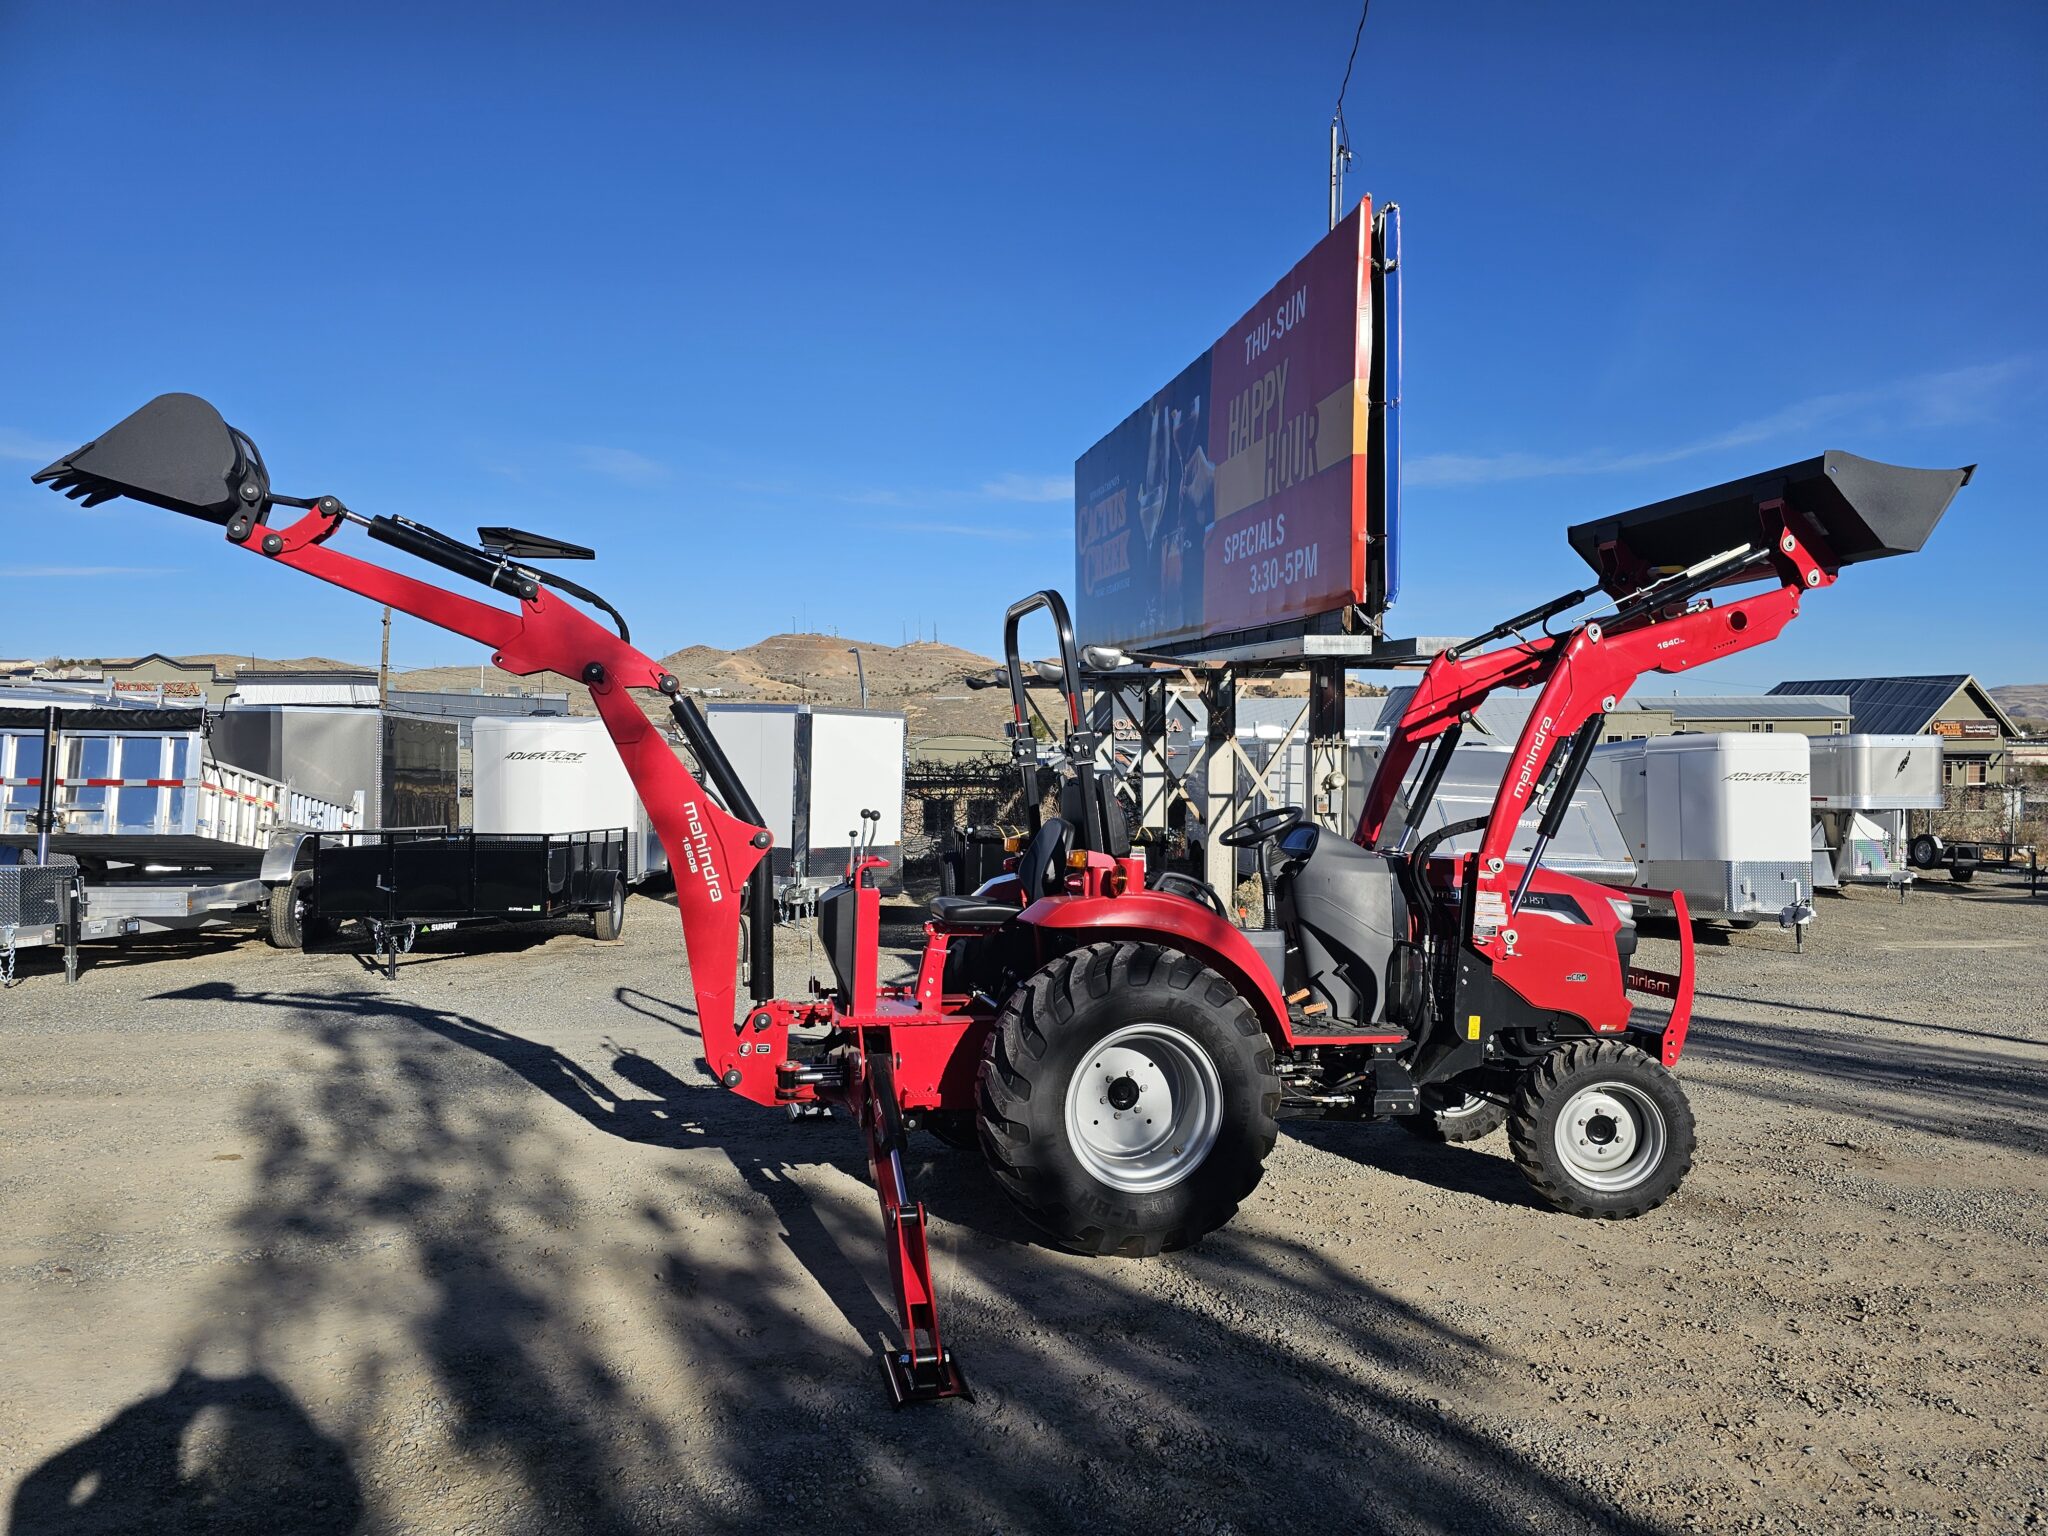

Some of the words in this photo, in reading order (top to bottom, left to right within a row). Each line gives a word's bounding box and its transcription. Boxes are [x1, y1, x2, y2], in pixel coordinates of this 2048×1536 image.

[1245, 285, 1307, 366] THU-SUN
[1227, 357, 1289, 463] HAPPY
[1265, 410, 1321, 498] HOUR
[1224, 513, 1285, 565] SPECIALS
[1249, 543, 1319, 595] 3:30-5PM
[115, 682, 202, 696] BONNZA
[502, 750, 588, 761] ADVENTURE
[1513, 716, 1553, 799] mahindra
[1720, 771, 1809, 782] ADVENTURE
[682, 836, 699, 874] 1660B
[683, 801, 722, 903] mahindra
[1529, 896, 1545, 905] HST
[431, 922, 458, 932] SUMMIT
